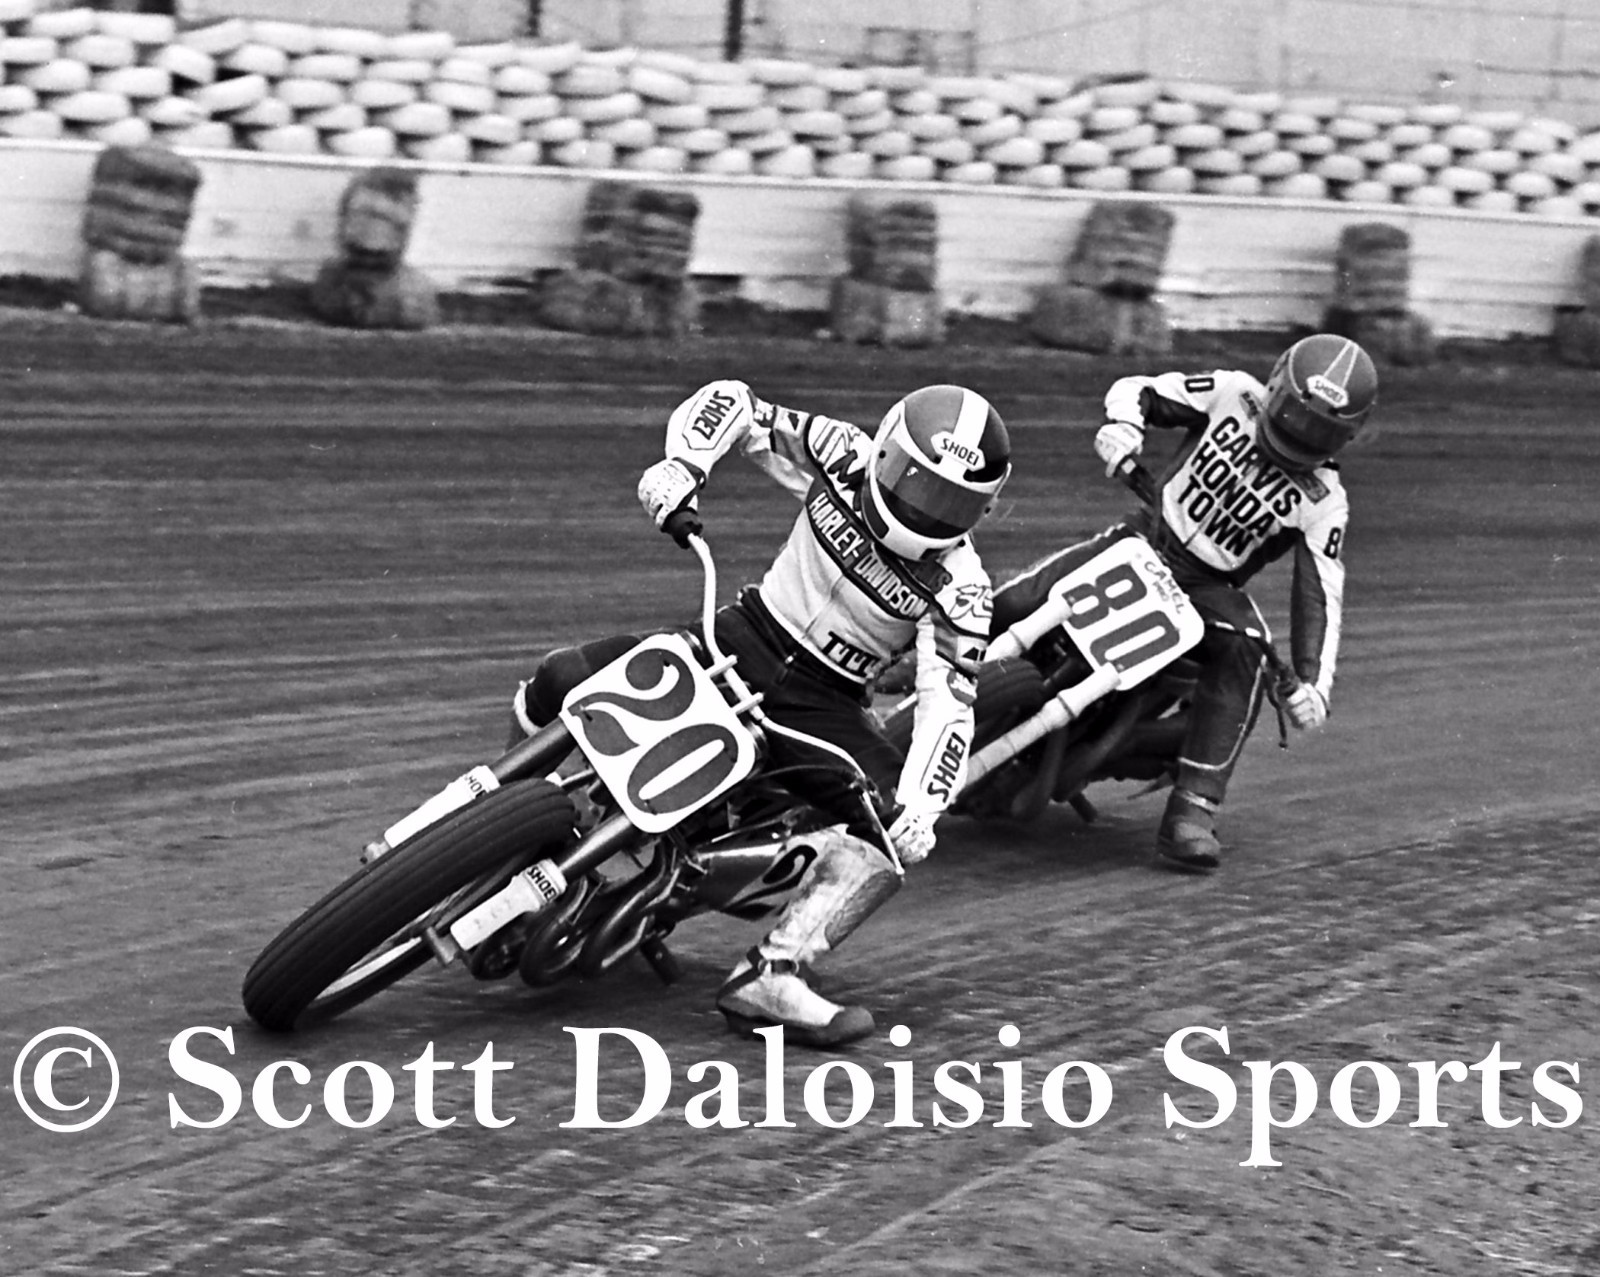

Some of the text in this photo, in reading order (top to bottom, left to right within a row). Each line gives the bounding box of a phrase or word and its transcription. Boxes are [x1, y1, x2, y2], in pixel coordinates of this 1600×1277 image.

[691, 389, 736, 440] SHOEI
[941, 437, 980, 468] SHOEI
[1191, 441, 1277, 537] HONDA
[1211, 416, 1302, 517] GARVIS
[1177, 475, 1255, 557] TOWN
[1324, 527, 1342, 559] 8
[1061, 563, 1181, 674] 80
[1144, 561, 1185, 615] CAMEL
[567, 648, 740, 815] 20
[928, 732, 968, 804] SHOEI
